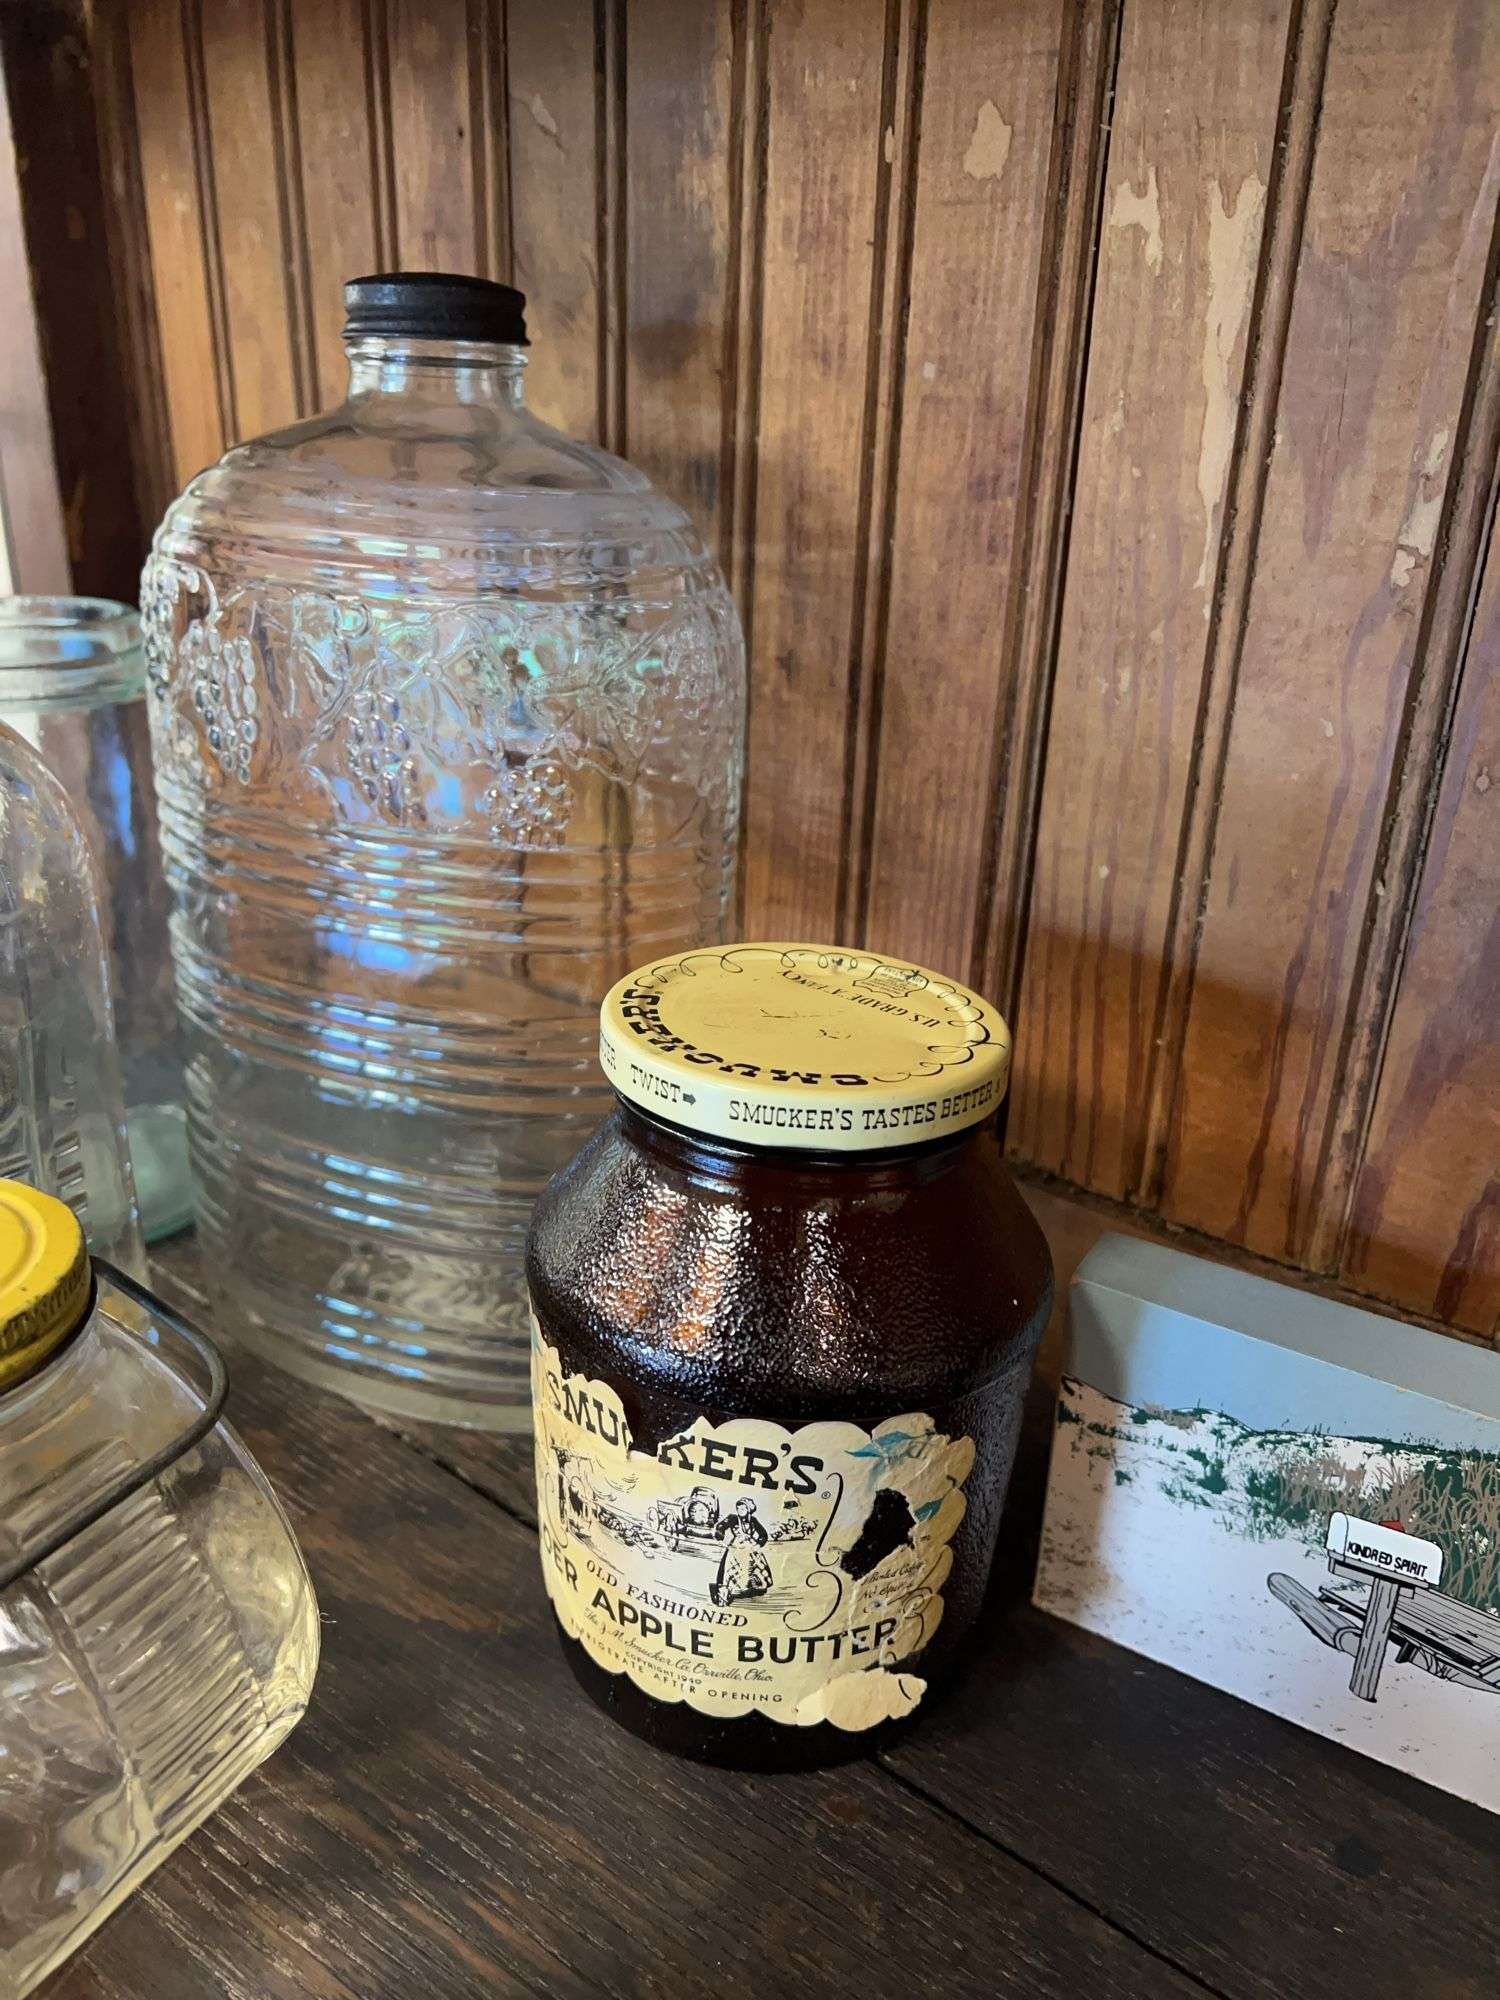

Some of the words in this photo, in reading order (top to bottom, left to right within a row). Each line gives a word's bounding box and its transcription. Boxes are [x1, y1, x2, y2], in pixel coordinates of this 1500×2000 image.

[848, 993, 908, 1017] GRADE
[619, 988, 869, 1087] SMUCKER'S
[630, 1063, 681, 1104] TWIST
[728, 1100, 853, 1131] SMUCKER'S
[861, 1101, 937, 1131] TASTES
[940, 1080, 993, 1120] BETTER
[1346, 1540, 1393, 1567] KINDRED
[1393, 1556, 1428, 1579] SPIRIT
[586, 1559, 618, 1588] OLD
[625, 1583, 749, 1628] FASHIONED
[591, 1586, 715, 1660] APPLE
[736, 1616, 899, 1665] BUTTER
[624, 1636, 672, 1666] Smucker
[707, 1688, 784, 1704] OPENING
